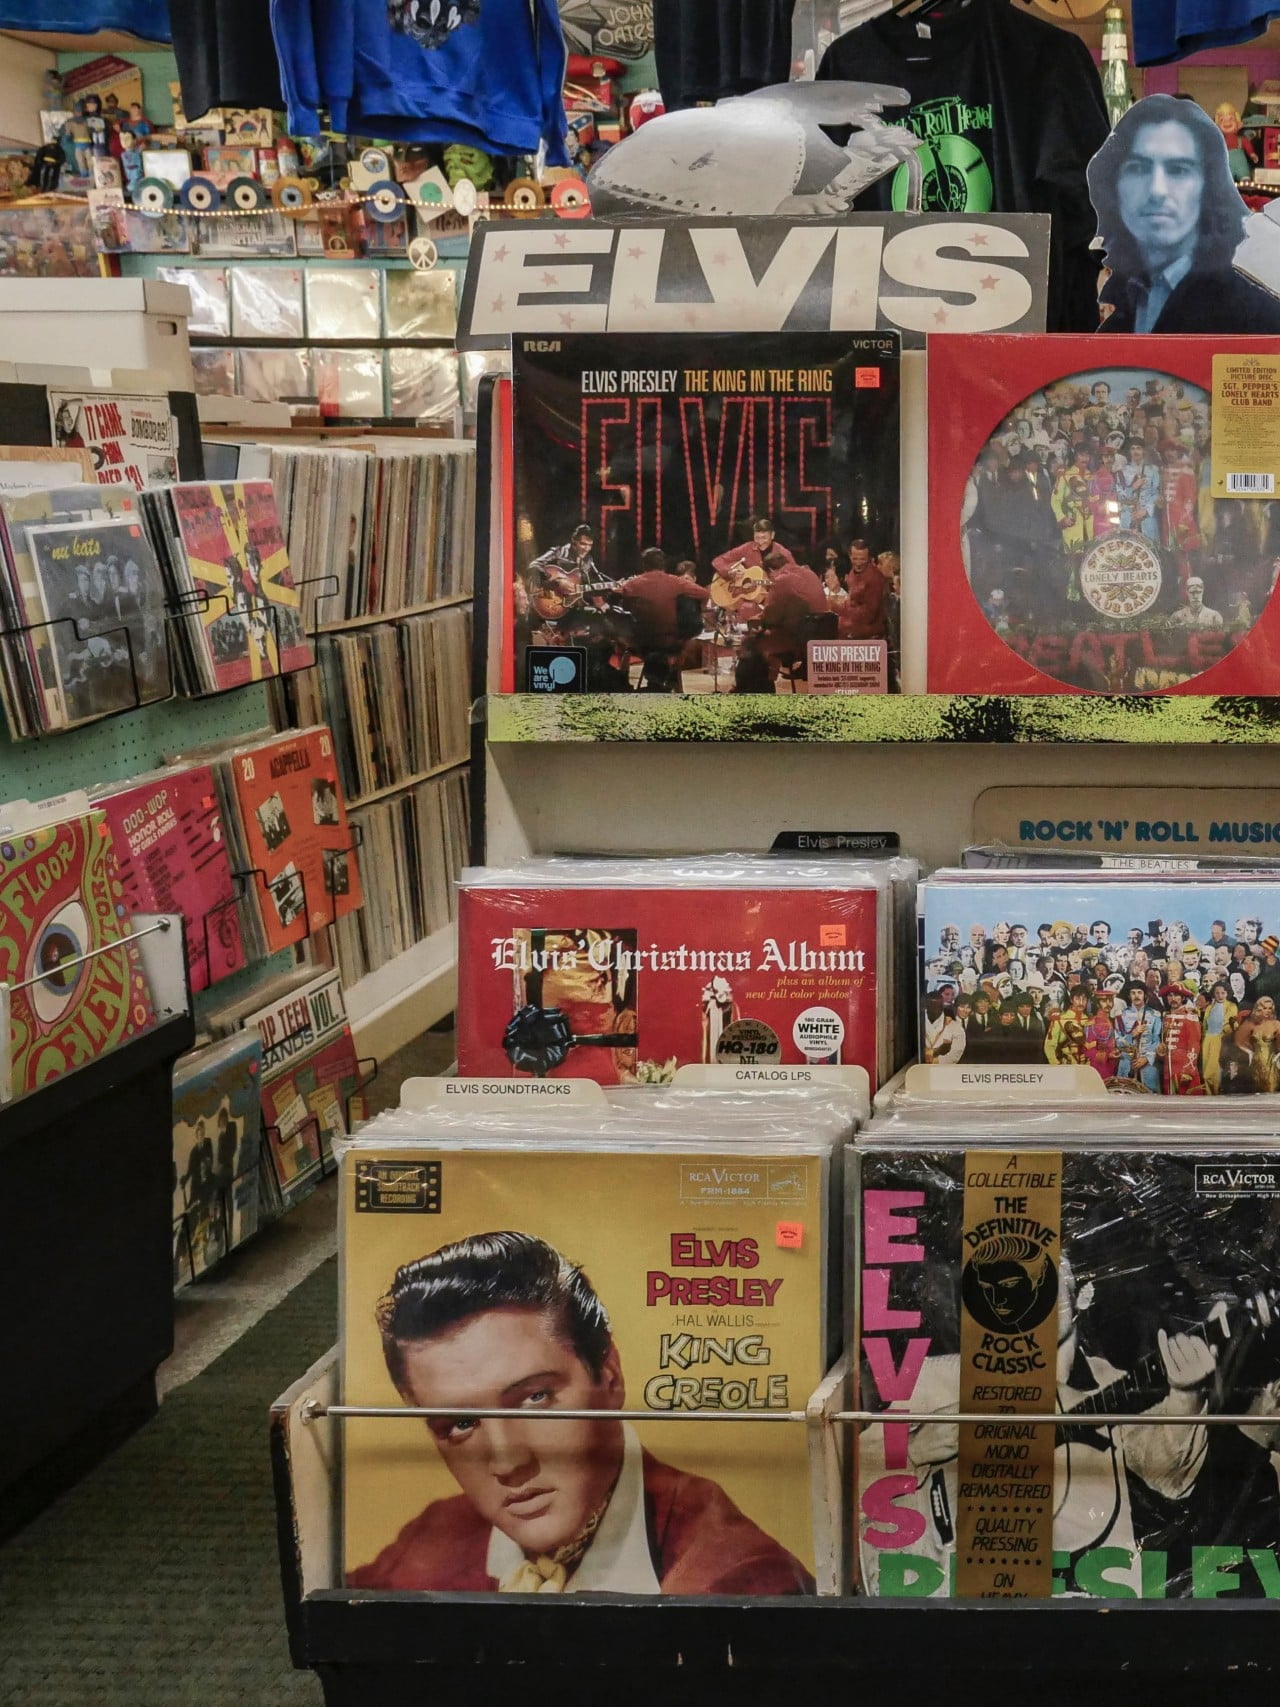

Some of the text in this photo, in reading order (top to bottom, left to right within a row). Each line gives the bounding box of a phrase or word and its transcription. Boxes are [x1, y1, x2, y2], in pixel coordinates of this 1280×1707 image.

[925, 102, 953, 137] Roll
[471, 222, 1032, 334] ELVIS
[523, 339, 893, 352] RCA VICTOR
[582, 369, 833, 393] ELVIS PRESLEY THE KING IN THE RING
[242, 757, 255, 781] 20
[320, 735, 331, 757] 20
[122, 790, 168, 834] DOO-WOP
[128, 808, 175, 848] HONOR ROLL
[1020, 821, 1092, 841] ROCK
[1098, 821, 1129, 841] 'N'
[1136, 821, 1199, 842] ROLL
[798, 836, 887, 850] Elvis Presley
[1112, 859, 1190, 870] THE BEATLES
[3, 840, 76, 942] FLOOR
[490, 937, 865, 973] Elvis' Christmas Album
[310, 991, 339, 1032] VOL.
[258, 996, 311, 1050] OP TEEN
[798, 1024, 840, 1034] WHITE
[719, 1041, 778, 1054] HQ-180
[736, 1071, 811, 1081] CATALOG LPS
[961, 1073, 1044, 1084] ELVIS PRESLEY
[446, 1084, 571, 1096] ELVIS SOUNDTRACKS
[1005, 1155, 1018, 1170] A
[966, 1171, 1057, 1189] COLLECTIBLE
[993, 1196, 1028, 1214] THE
[964, 1218, 1059, 1248] DEFINITIVE
[670, 1232, 760, 1269] ELVIS
[646, 1271, 784, 1307] PRESLEY
[676, 1315, 754, 1327] HAL WALLIS
[660, 1333, 771, 1370] KING
[980, 1333, 1040, 1353] ROCK
[861, 1189, 931, 1550] ELVIS
[972, 1352, 1047, 1375] CLASSIC
[644, 1374, 789, 1411] CREOLE
[972, 1386, 1042, 1401] RESTORED
[974, 1424, 1038, 1440] ORIGINAL
[984, 1445, 1029, 1460] MONO
[971, 1464, 1039, 1480] DIGITALLY
[959, 1483, 1050, 1499] REMASTERED
[975, 1518, 1036, 1534] QUALITY
[971, 1537, 1038, 1552] PRESSING
[993, 1573, 1015, 1588] ON
